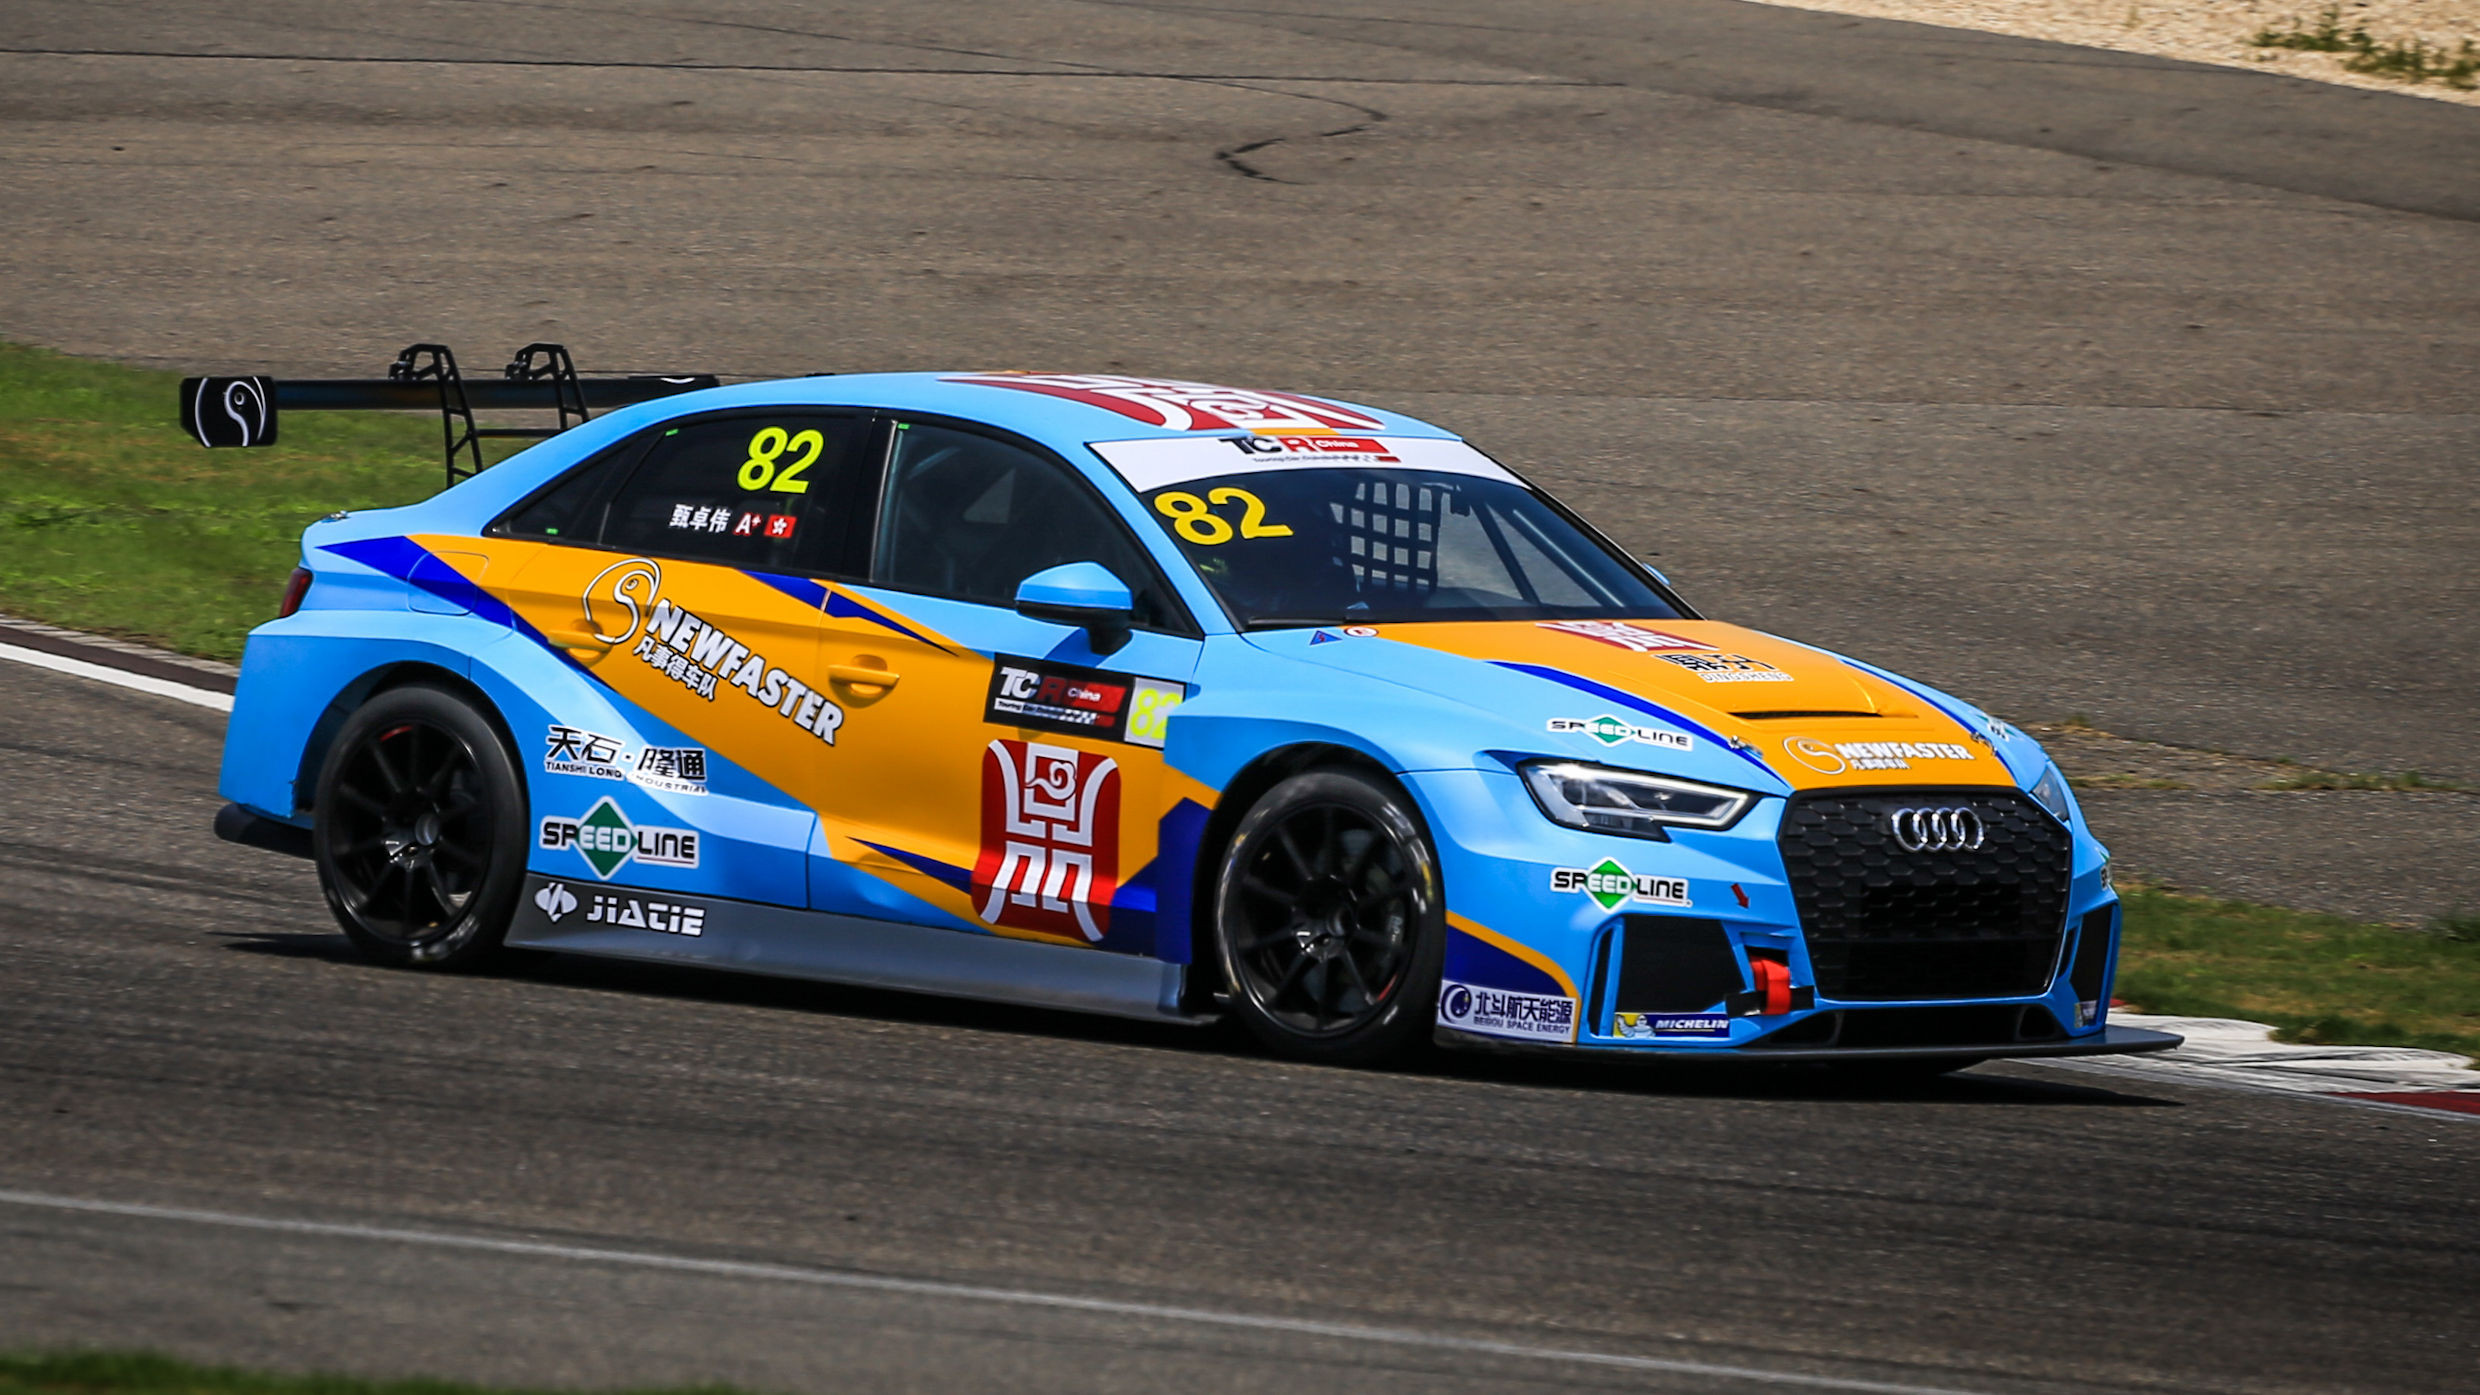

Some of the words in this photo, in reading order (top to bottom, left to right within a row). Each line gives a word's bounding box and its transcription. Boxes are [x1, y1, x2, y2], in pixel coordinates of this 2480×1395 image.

[737, 426, 825, 494] 82
[1218, 436, 1320, 454] TCR
[668, 503, 732, 533] 甄卓伟
[1154, 487, 1294, 545] 82
[644, 598, 844, 747] NEWFASTER
[1000, 666, 1067, 701] TCR
[1067, 686, 1102, 702] China
[1129, 688, 1183, 739] 82
[1834, 742, 1975, 760] NEWFASTER
[546, 761, 586, 774] TIANSHI
[588, 766, 623, 778] LONG
[1474, 992, 1573, 1025] 北斗航天能源
[1655, 1019, 1729, 1029] MICHELIN
[1507, 1021, 1533, 1032] SPACE
[1536, 1024, 1570, 1034] ENERGY
